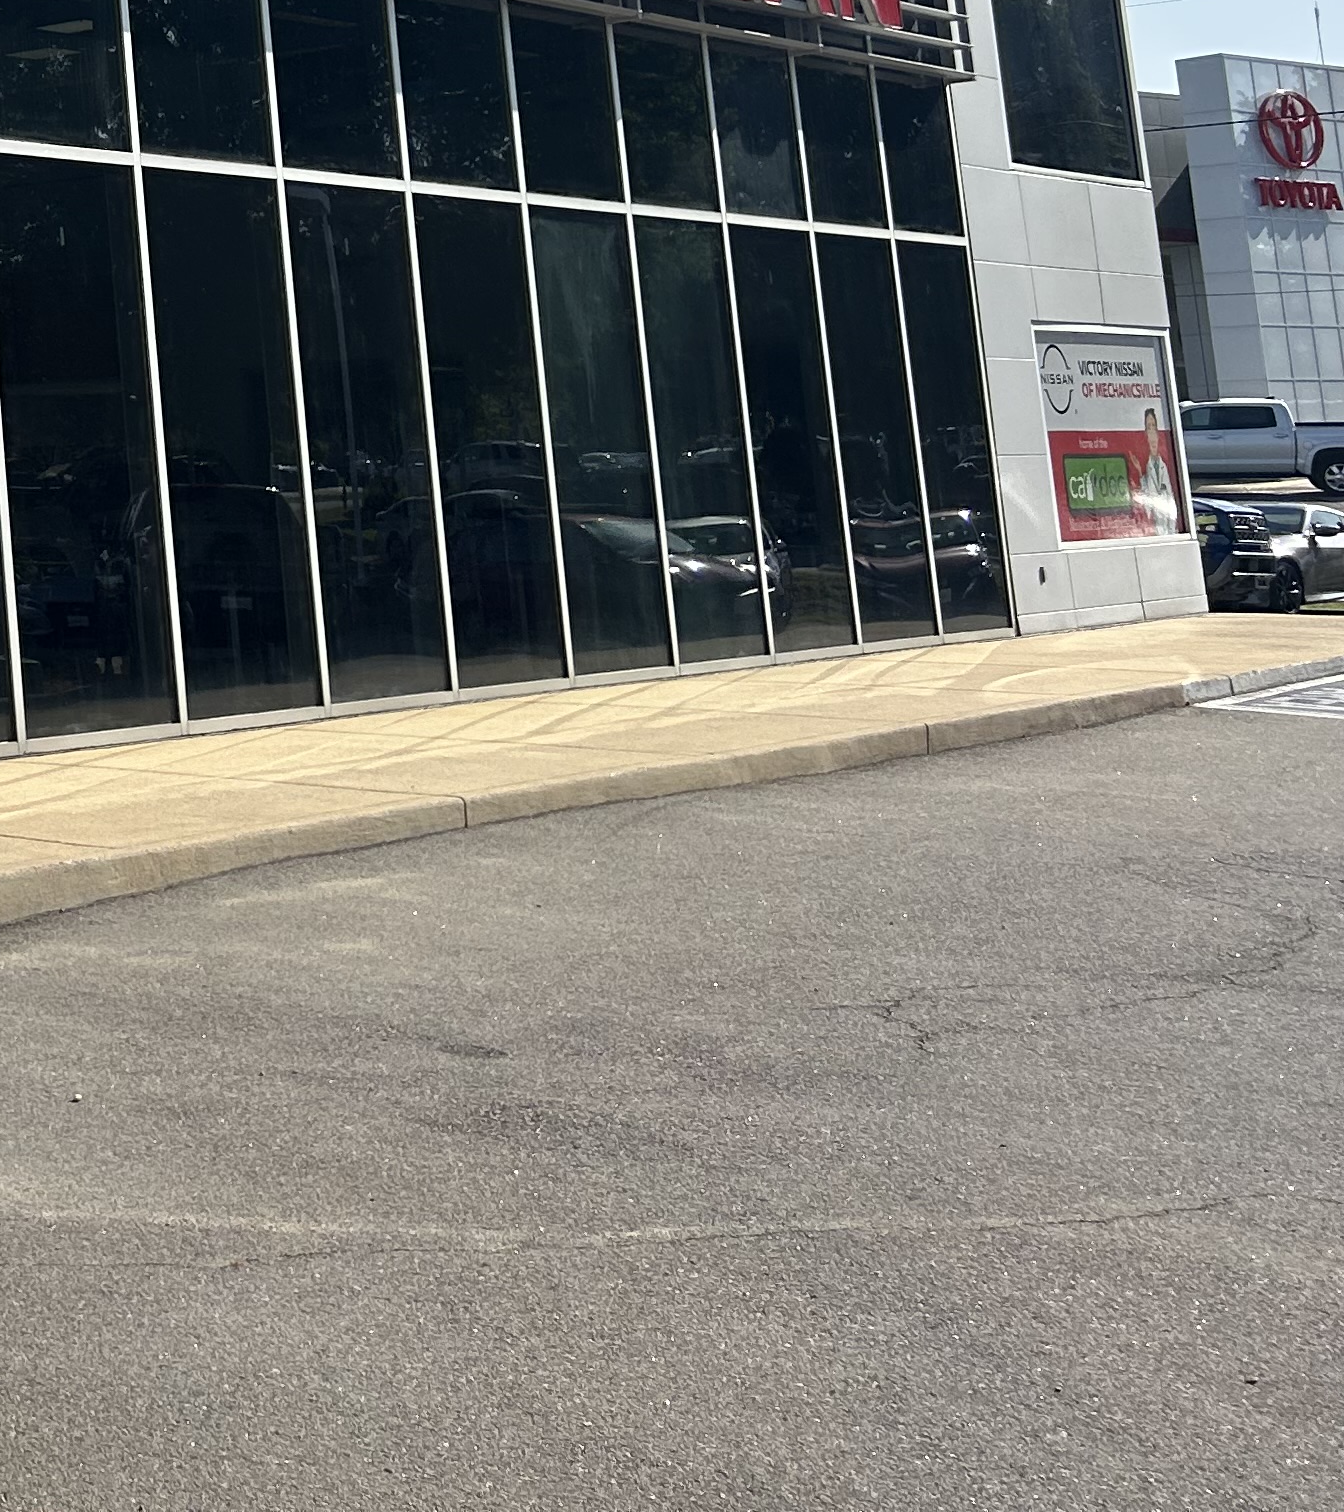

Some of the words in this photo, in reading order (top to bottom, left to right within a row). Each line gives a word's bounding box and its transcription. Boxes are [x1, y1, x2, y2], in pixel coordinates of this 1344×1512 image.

[1255, 177, 1343, 211] TOYOTA
[1077, 360, 1113, 377] VICTORY
[1115, 361, 1143, 377] NISSAN
[1041, 373, 1073, 385] NISSAN
[1082, 383, 1094, 398] OF
[1095, 383, 1161, 398] MECHANICSVILLE
